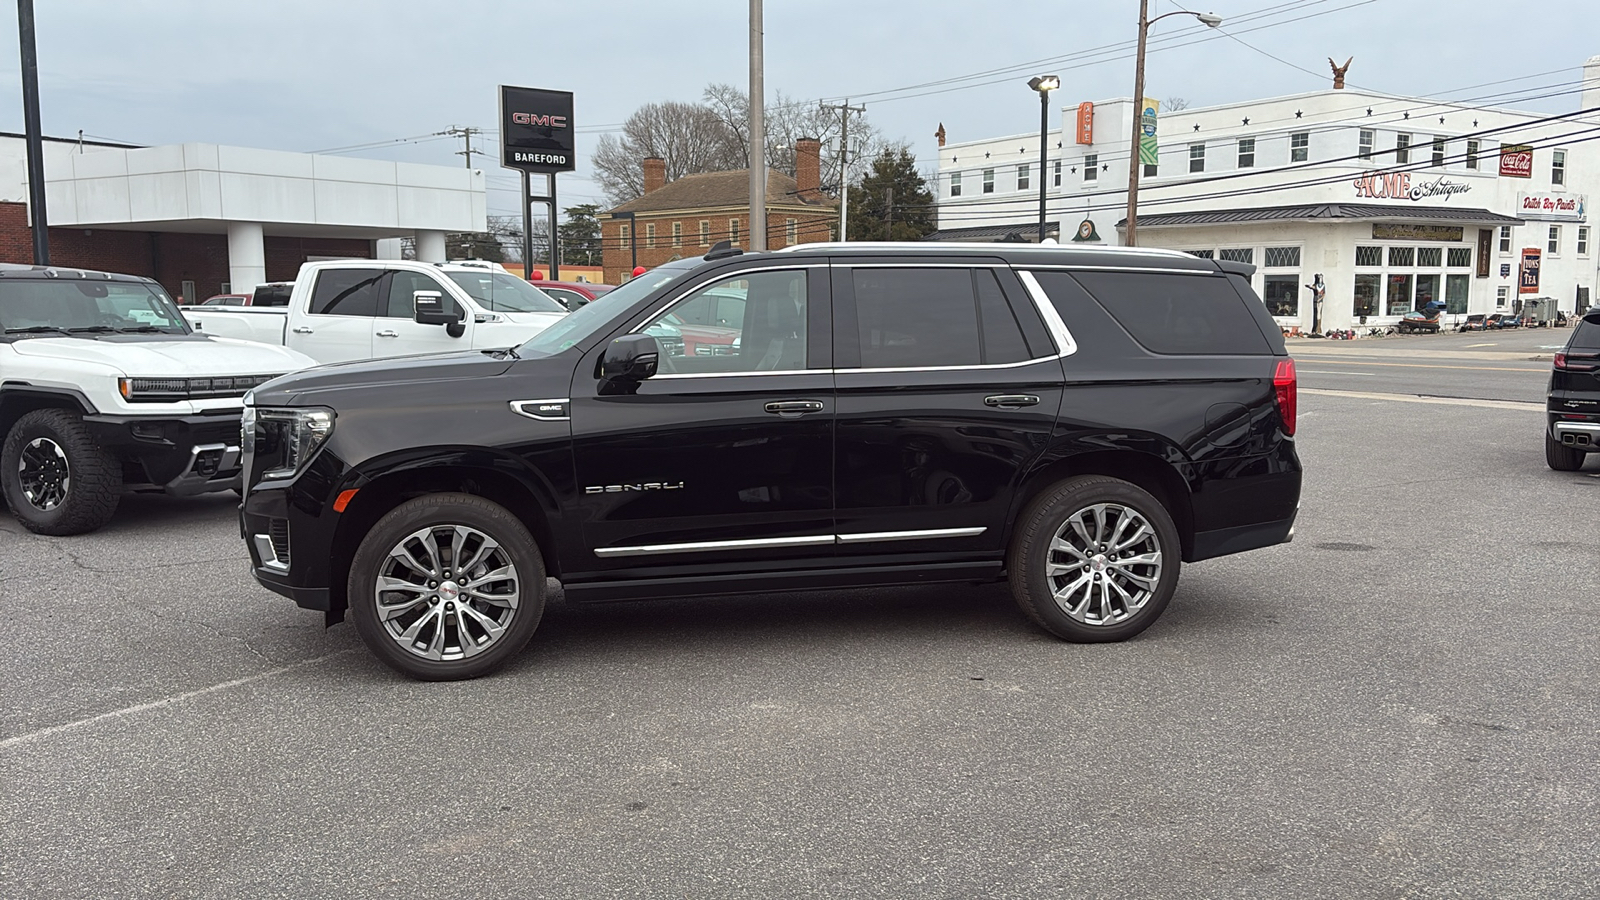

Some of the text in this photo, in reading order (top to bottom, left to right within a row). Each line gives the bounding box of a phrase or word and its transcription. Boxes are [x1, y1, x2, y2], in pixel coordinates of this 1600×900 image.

[512, 112, 567, 128] GMC
[514, 152, 566, 164] BAREFORD
[1354, 170, 1472, 202] ACME Antiques
[1523, 196, 1576, 212] Dutch Boy Paints
[1523, 273, 1537, 285] TEA
[539, 404, 562, 412] GMC
[585, 481, 684, 494] DENALI
